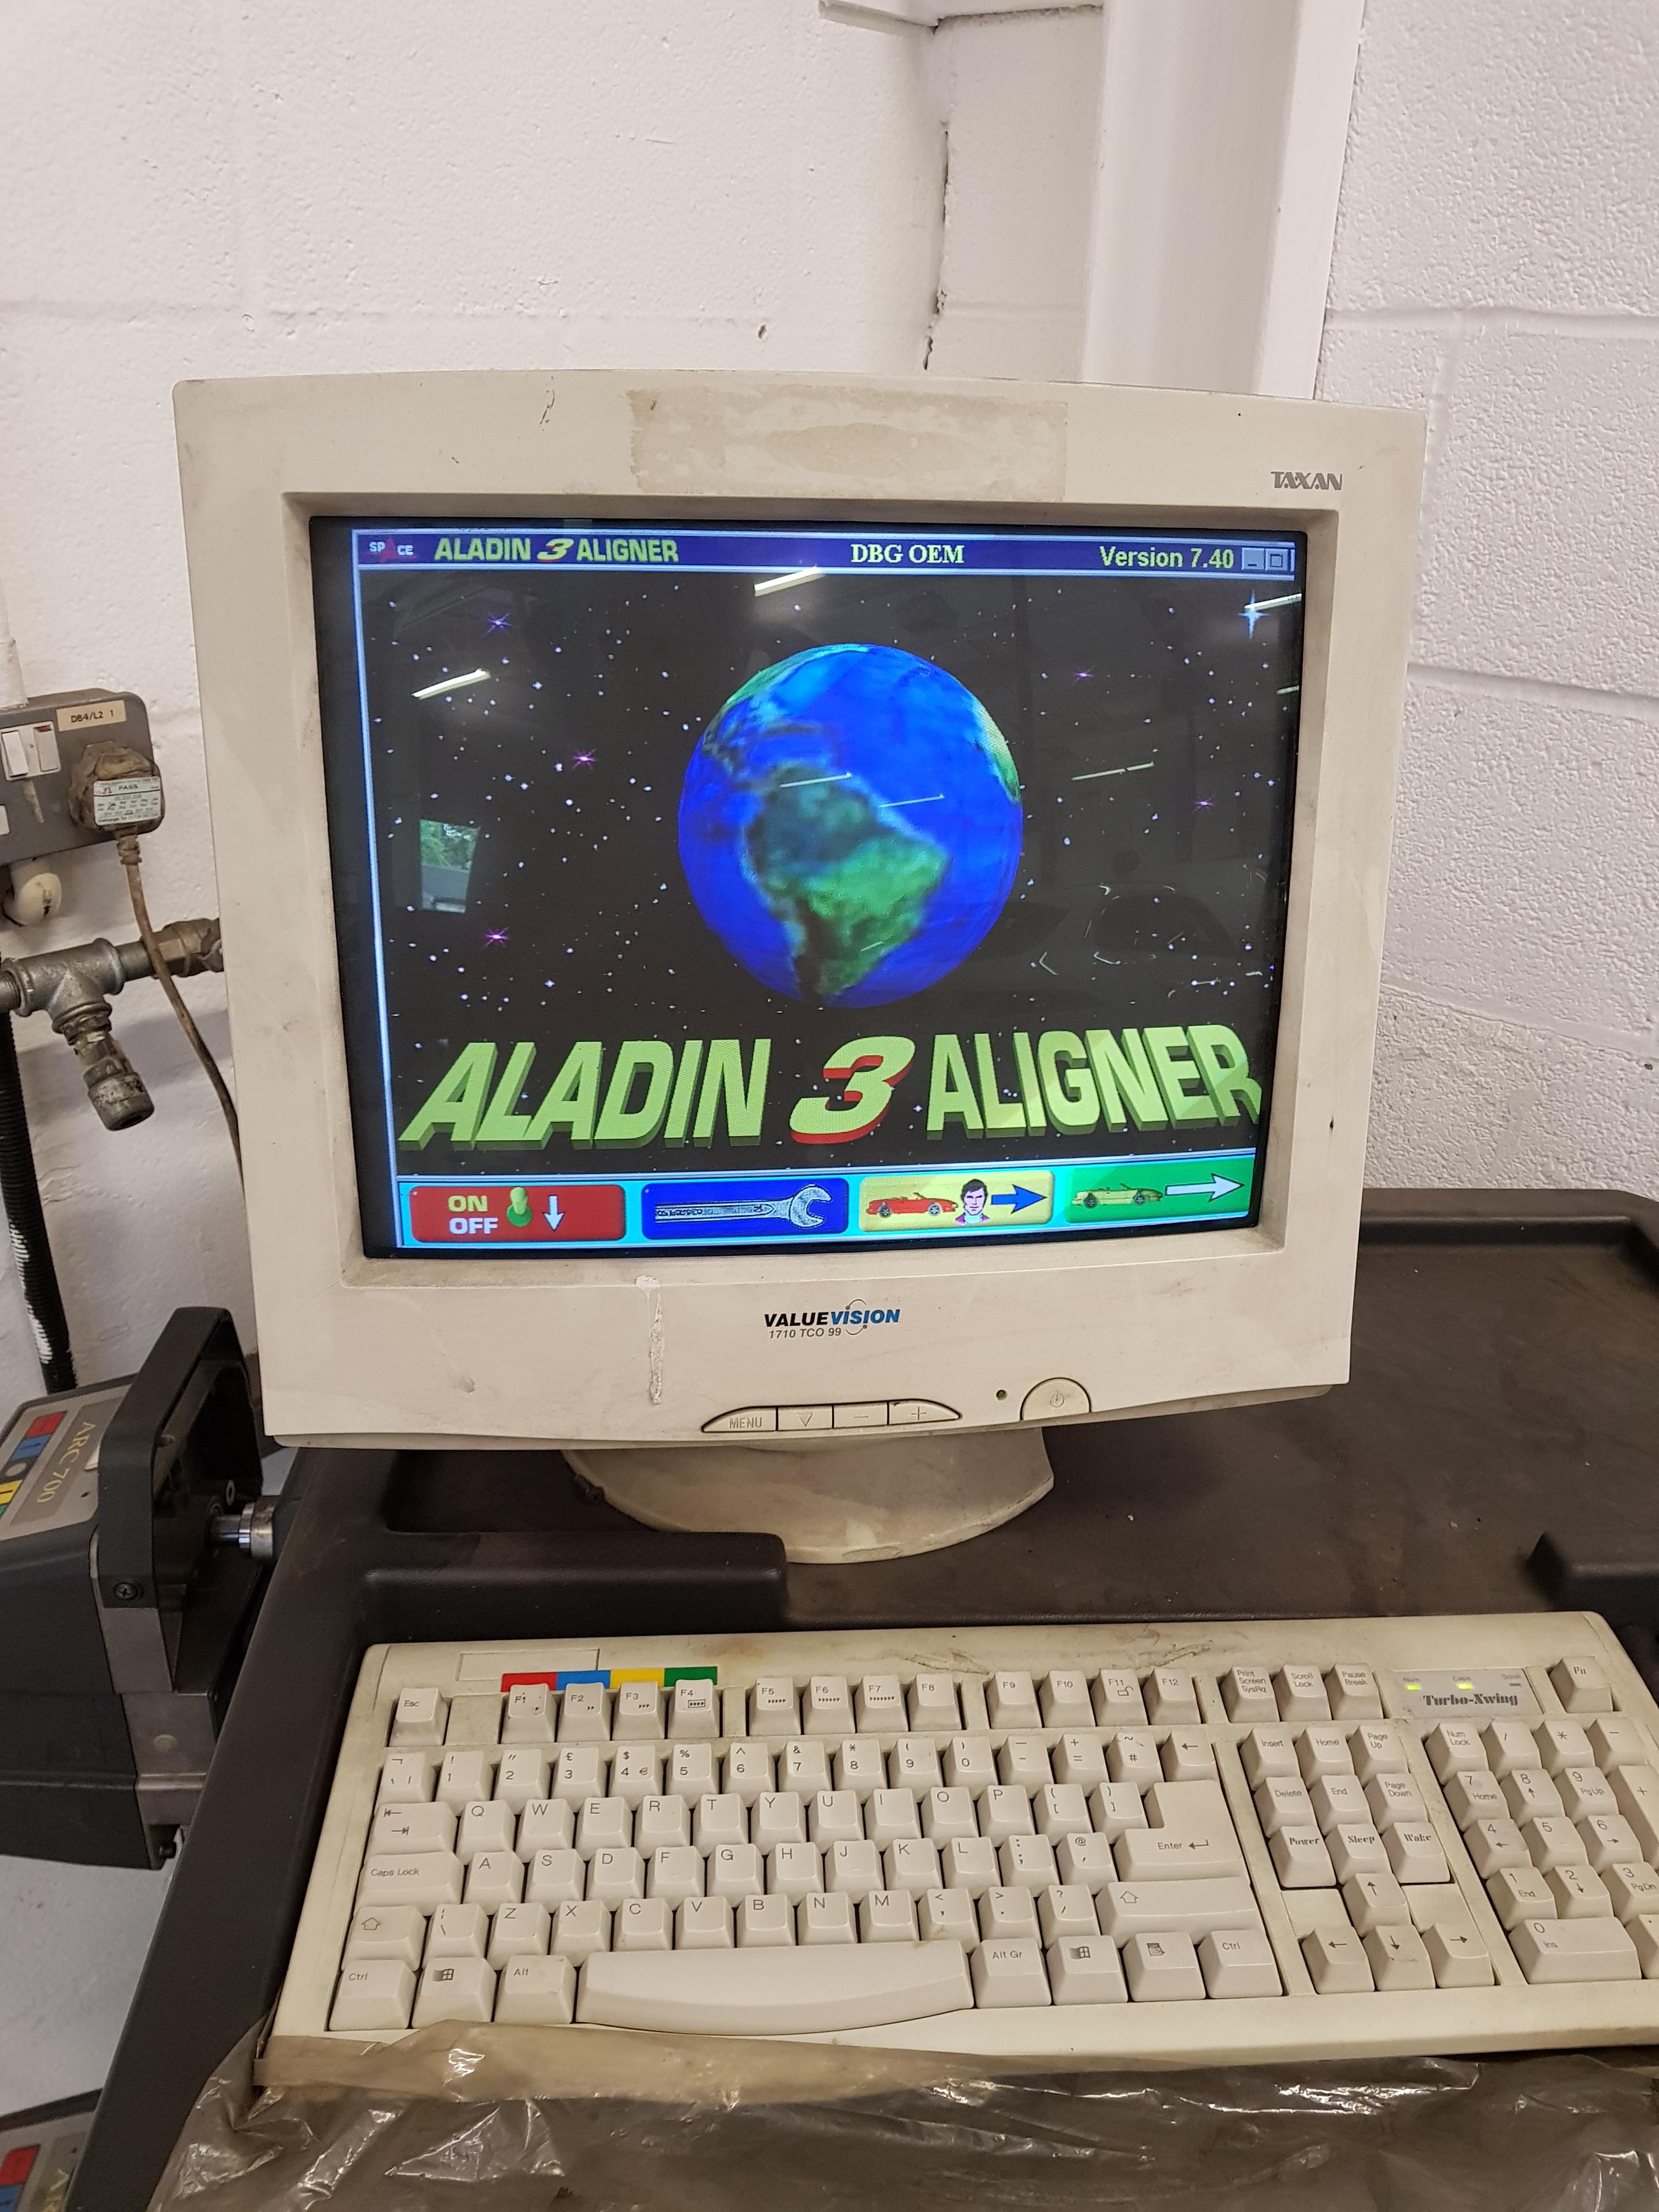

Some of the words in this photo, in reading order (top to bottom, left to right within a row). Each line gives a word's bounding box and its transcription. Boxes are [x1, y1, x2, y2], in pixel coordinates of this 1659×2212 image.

[1271, 471, 1344, 491] TAXAN
[434, 537, 531, 561] ALADIN
[537, 538, 574, 563] 3
[576, 537, 679, 563] ALIGNER
[850, 544, 902, 563] DBG
[909, 544, 965, 565] OEM
[1099, 545, 1183, 568] Version
[1189, 549, 1235, 571] 7.40
[71, 711, 103, 723] DB4/L2
[398, 1037, 772, 1150] ALADIN
[788, 1035, 917, 1145] 3
[926, 1024, 1263, 1141] ALIGNER
[448, 1195, 489, 1212] ON
[449, 1217, 498, 1234] OFF
[769, 1329, 796, 1339] 1710
[800, 1328, 824, 1338] TCO
[828, 1327, 842, 1336] 99
[729, 1417, 763, 1429] MENU
[59, 1421, 95, 1465] ARC
[922, 1683, 935, 1691] F8
[1108, 1678, 1124, 1686] F11
[1423, 1693, 1518, 1706] Turbo-Xwing
[1367, 1733, 1388, 1741] Page
[1370, 1741, 1383, 1749] Up
[793, 1762, 802, 1771] 7
[850, 1760, 859, 1770] 8
[906, 1759, 914, 1768] 9
[961, 1758, 970, 1767] 0
[565, 1769, 573, 1779] 3
[620, 1767, 629, 1776] 4
[680, 1767, 689, 1775] 5
[736, 1764, 745, 1773] 6
[506, 1770, 514, 1780] 2
[1465, 1775, 1472, 1786] 7
[1520, 1773, 1531, 1784] 8
[1572, 1771, 1583, 1782] 9
[1384, 1781, 1406, 1790] Page
[936, 1791, 950, 1803] O
[993, 1789, 1003, 1801] P
[1580, 1787, 1604, 1797] PgUp
[649, 1800, 661, 1812] R
[706, 1799, 717, 1810] T
[765, 1797, 776, 1809] Y
[822, 1795, 833, 1807] U
[471, 1805, 484, 1817] Q
[532, 1804, 549, 1816] W
[590, 1803, 600, 1814] E
[1487, 1824, 1497, 1834] 4
[1542, 1822, 1553, 1832] 5
[1596, 1819, 1607, 1830] 6
[1289, 1837, 1319, 1846] Power
[1347, 1835, 1375, 1844] Sleep
[1403, 1833, 1431, 1842] Wake
[839, 1846, 848, 1857] J
[898, 1843, 910, 1855] K
[958, 1842, 968, 1854] L
[1157, 1842, 1182, 1850] Enter
[602, 1853, 613, 1865] D
[661, 1852, 670, 1863] F
[720, 1849, 733, 1861] G
[781, 1848, 793, 1860] H
[478, 1858, 491, 1869] A
[541, 1855, 552, 1866] S
[370, 1869, 394, 1877] Caps
[1565, 1870, 1578, 1880] 2
[1623, 1867, 1635, 1878] 3
[1630, 1883, 1657, 1892] PgDn
[753, 1899, 765, 1910] B
[814, 1897, 825, 1909] N
[874, 1894, 889, 1906] M
[565, 1905, 577, 1917] X
[629, 1903, 641, 1915] C
[691, 1901, 703, 1912] V
[504, 1908, 517, 1919] Z
[1533, 1922, 1545, 1933] 0
[1222, 1942, 1240, 1950] Ctrl
[992, 1951, 1007, 1959] Alt
[1010, 1950, 1023, 1959] Gr
[348, 1972, 368, 1981] Ctrl
[513, 1968, 529, 1976] Alt
